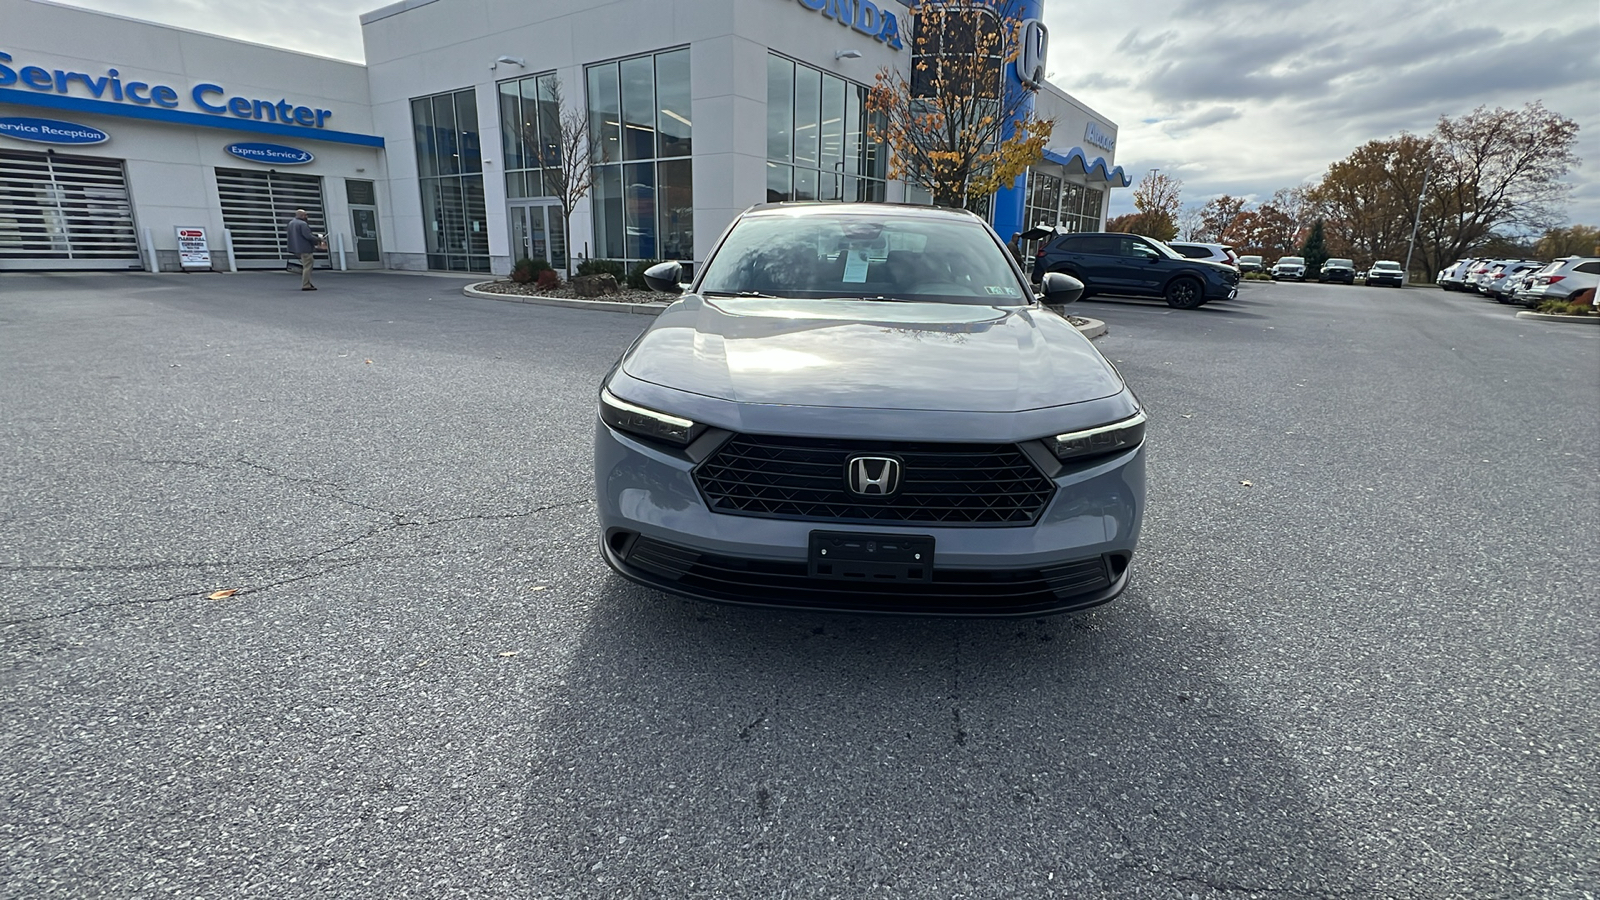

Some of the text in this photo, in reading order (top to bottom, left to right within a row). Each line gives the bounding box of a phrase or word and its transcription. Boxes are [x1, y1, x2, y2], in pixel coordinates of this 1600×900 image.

[797, 0, 903, 50] NDA
[0, 51, 332, 128] Service Center
[0, 123, 101, 139] ervice Reception
[231, 146, 297, 159] Express Service
